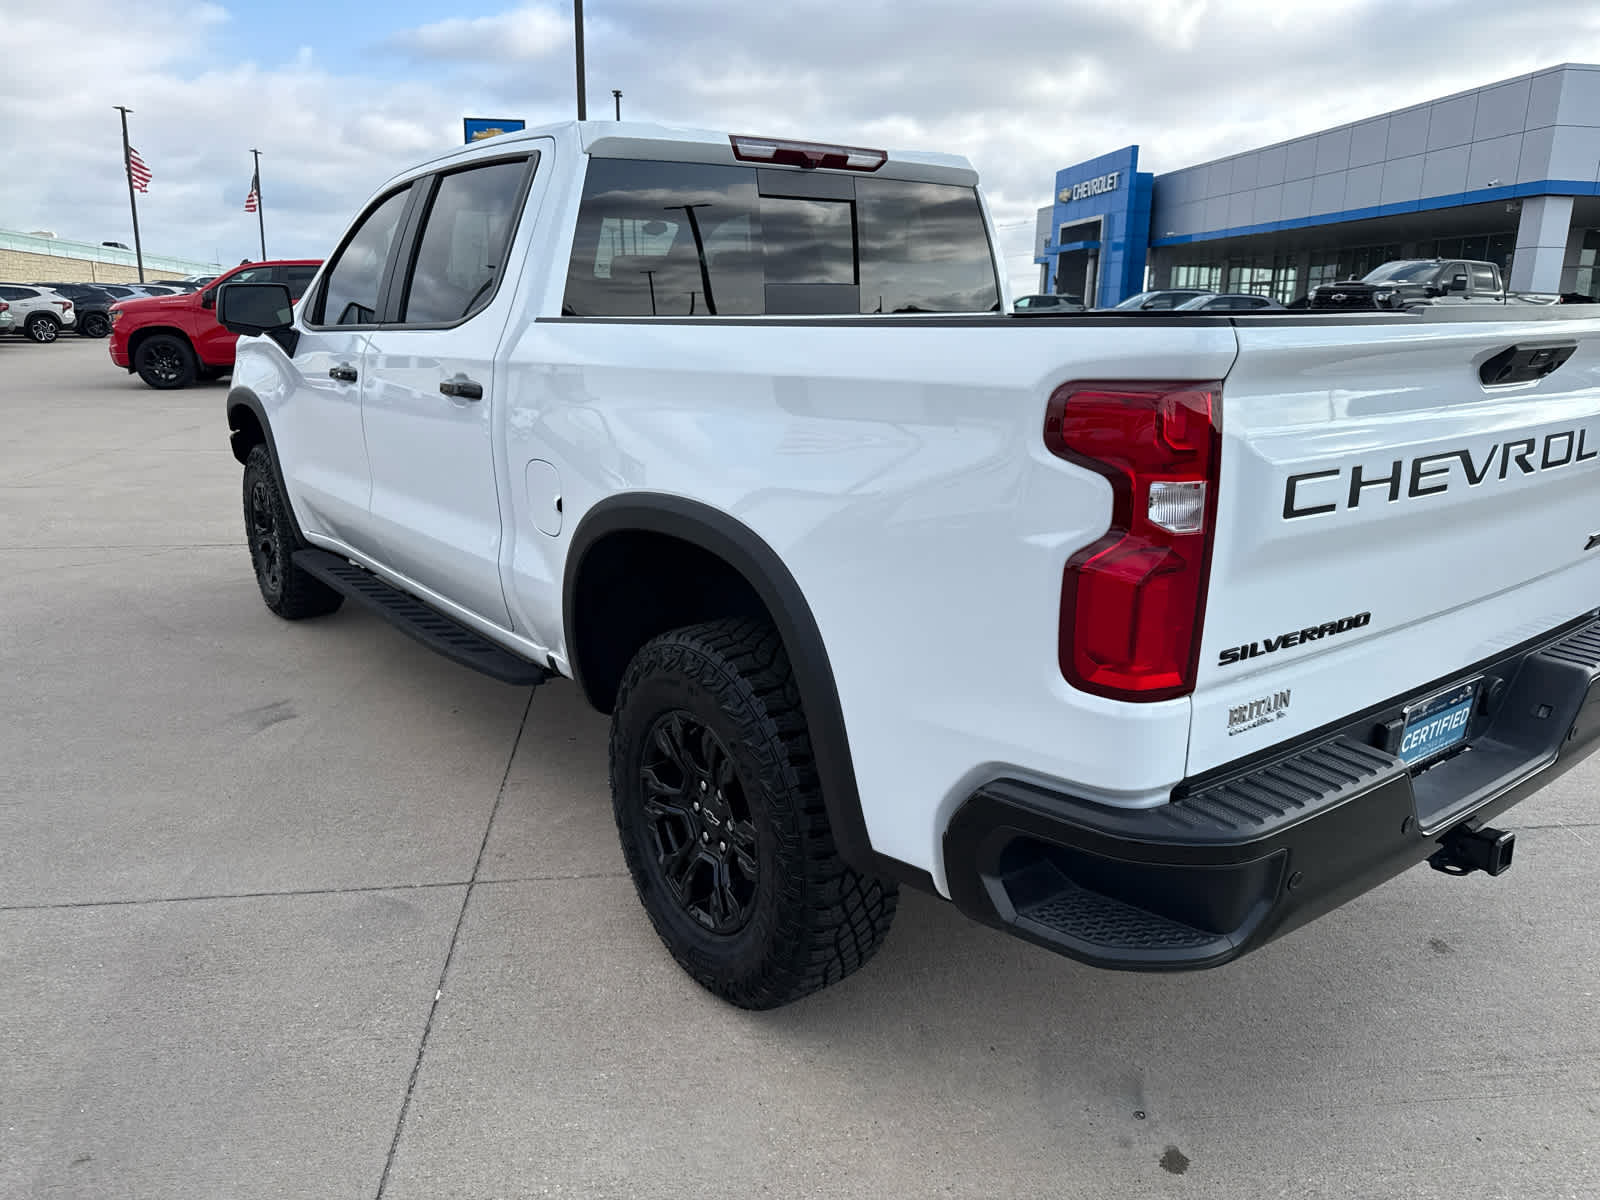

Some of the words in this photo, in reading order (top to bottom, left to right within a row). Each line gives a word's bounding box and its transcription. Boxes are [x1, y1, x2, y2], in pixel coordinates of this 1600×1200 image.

[1072, 171, 1120, 201] CHEVROLET
[1217, 611, 1371, 666] SILVERADO
[1227, 688, 1291, 728] BRITAIN
[1401, 707, 1470, 752] CERTIFIED
